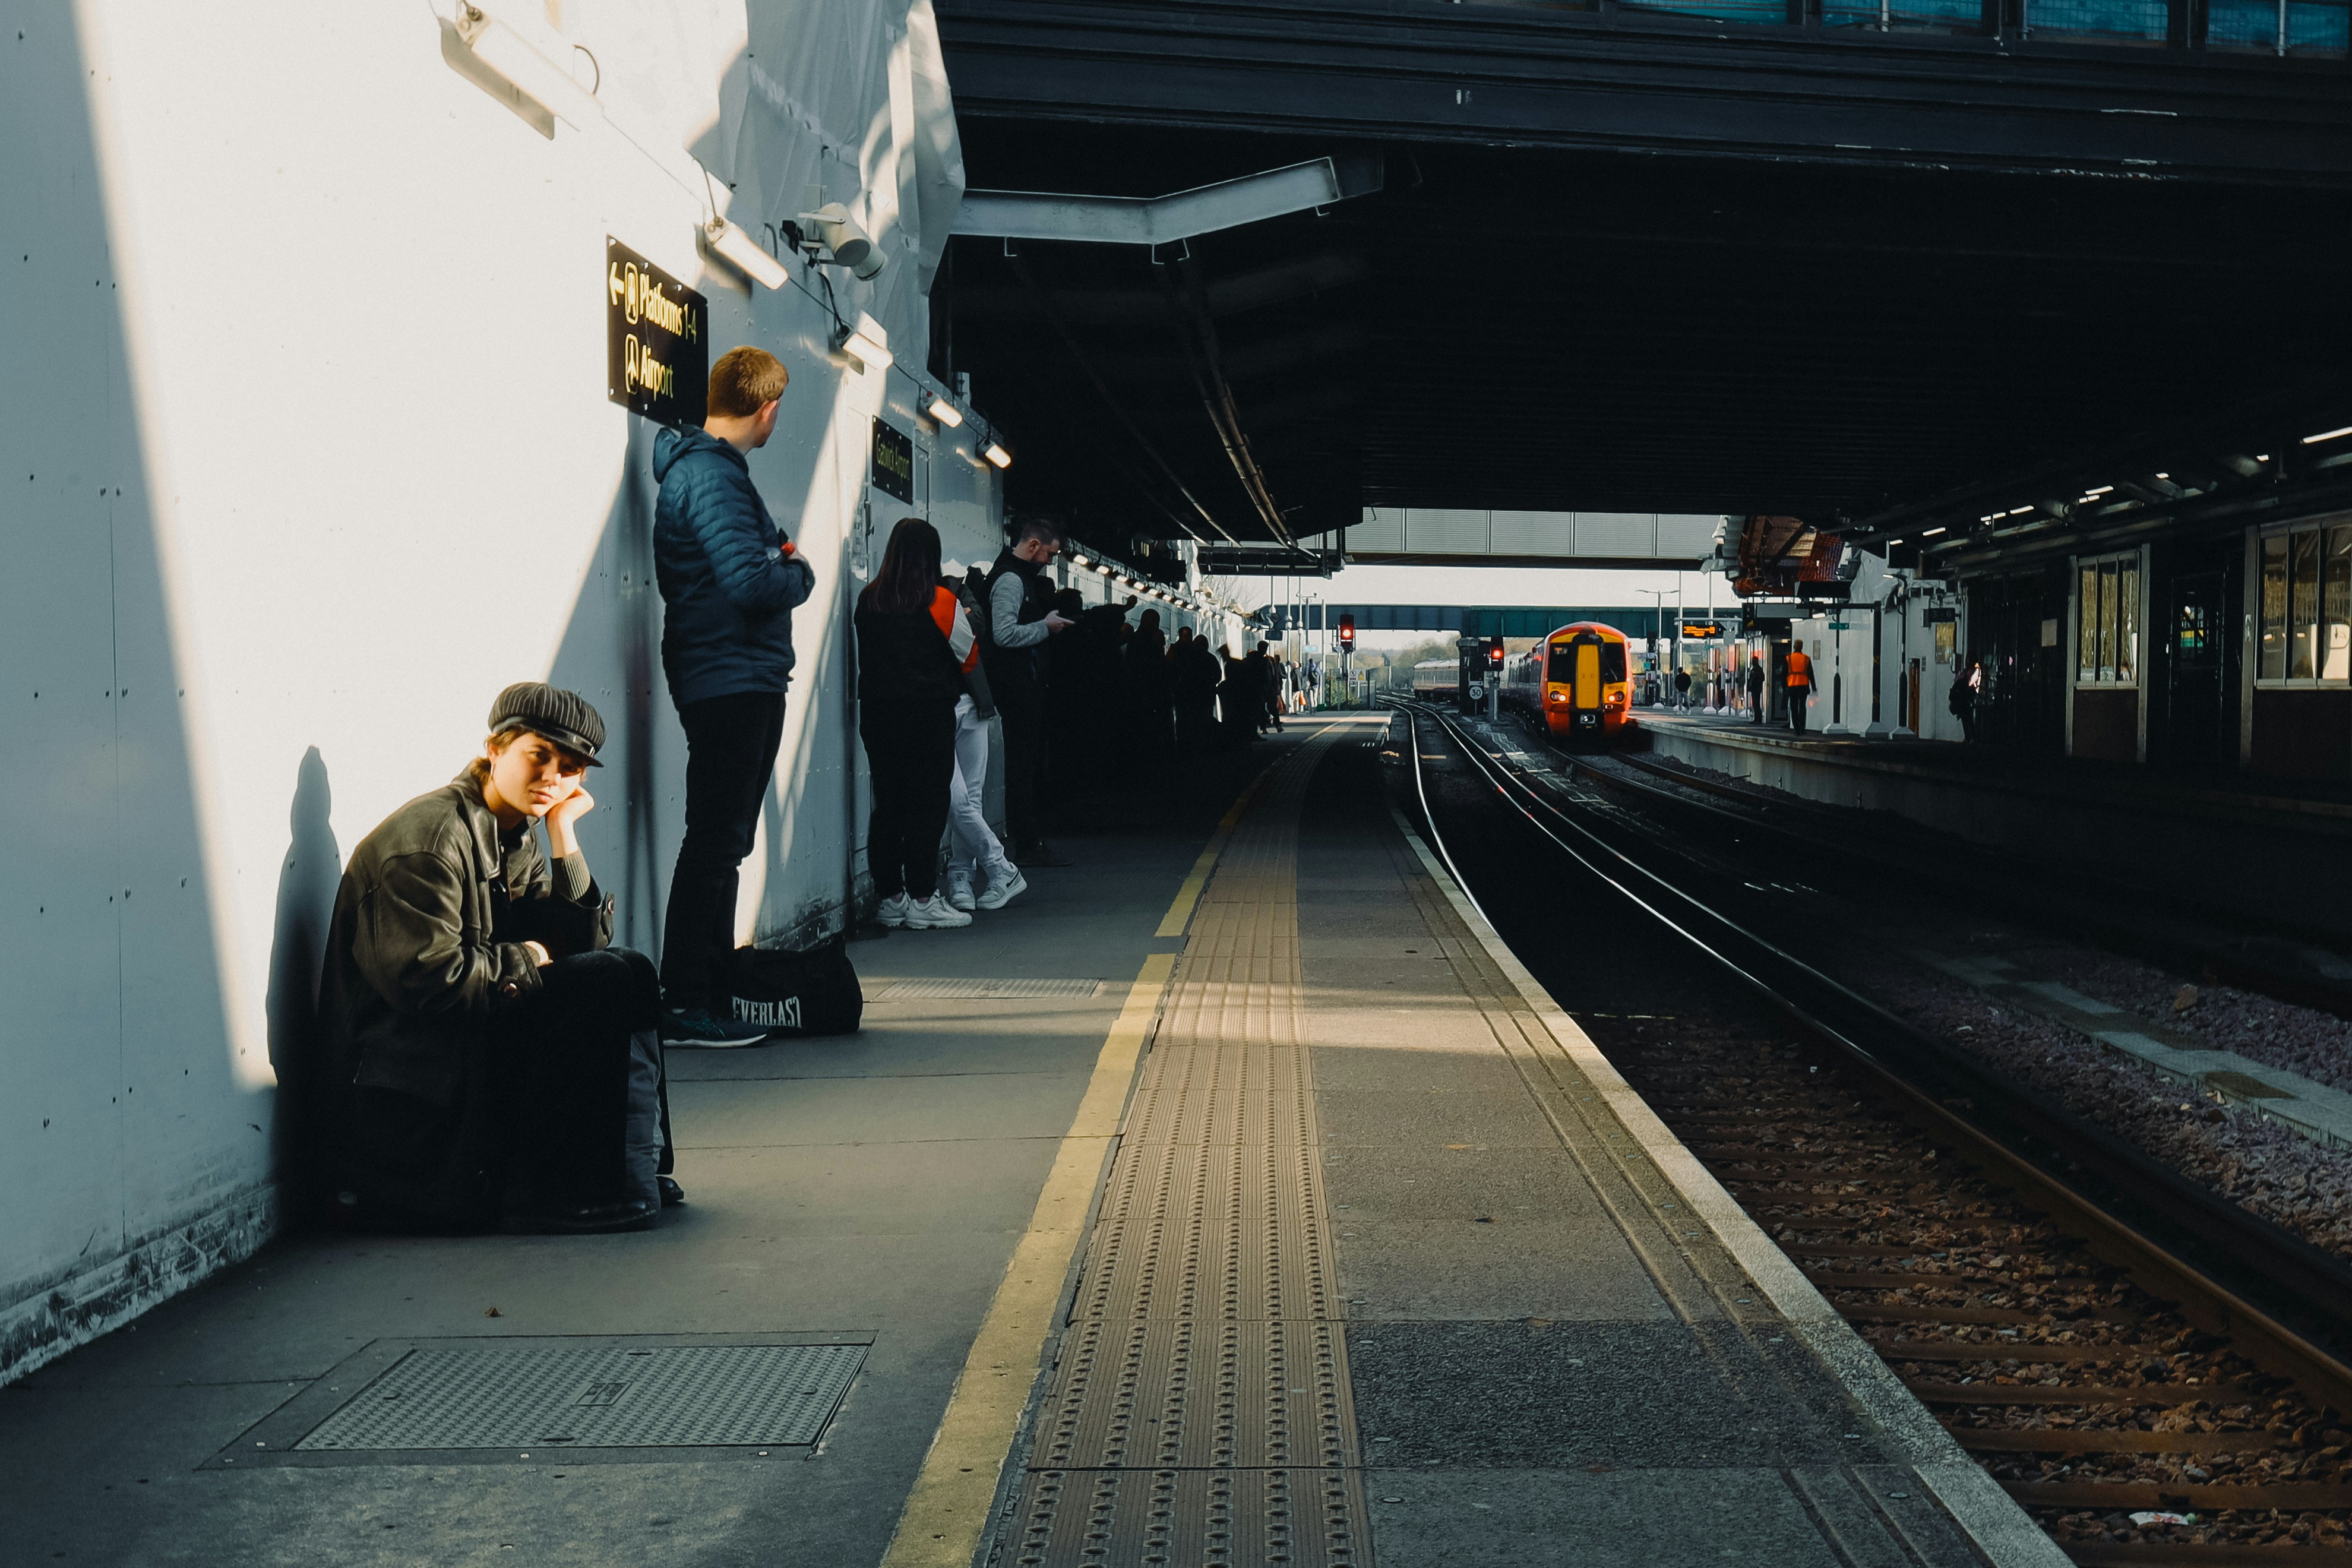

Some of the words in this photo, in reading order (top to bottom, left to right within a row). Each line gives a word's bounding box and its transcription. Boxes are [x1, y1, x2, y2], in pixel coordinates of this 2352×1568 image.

[640, 273, 682, 337] Platforms
[640, 344, 674, 402] Airport
[877, 433, 894, 472] Gatwick
[895, 445, 910, 485] Airport
[732, 995, 802, 1029] EVERLAST
